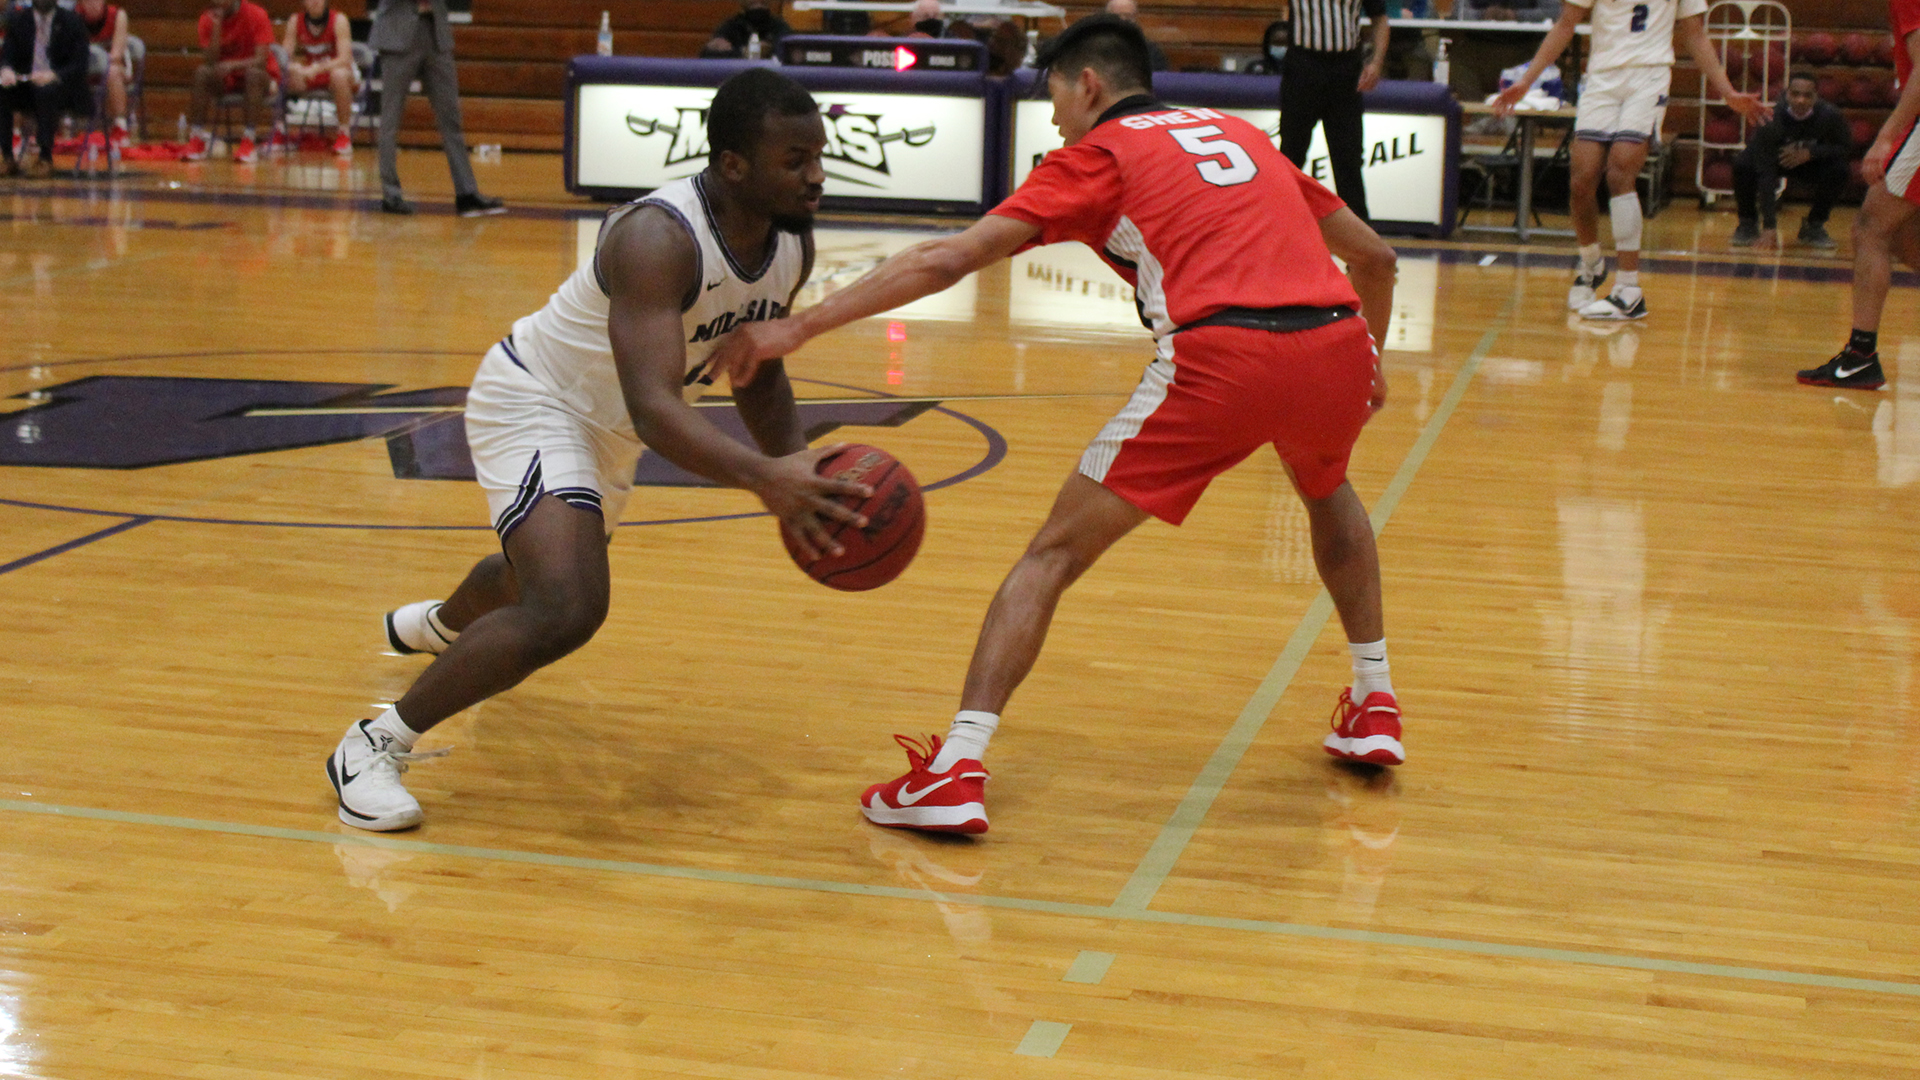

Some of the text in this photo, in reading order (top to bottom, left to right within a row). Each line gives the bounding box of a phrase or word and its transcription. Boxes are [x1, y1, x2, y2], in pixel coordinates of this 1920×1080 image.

[1631, 4, 1648, 32] 2
[1119, 107, 1225, 130] SHEN
[1167, 124, 1259, 188] 5
